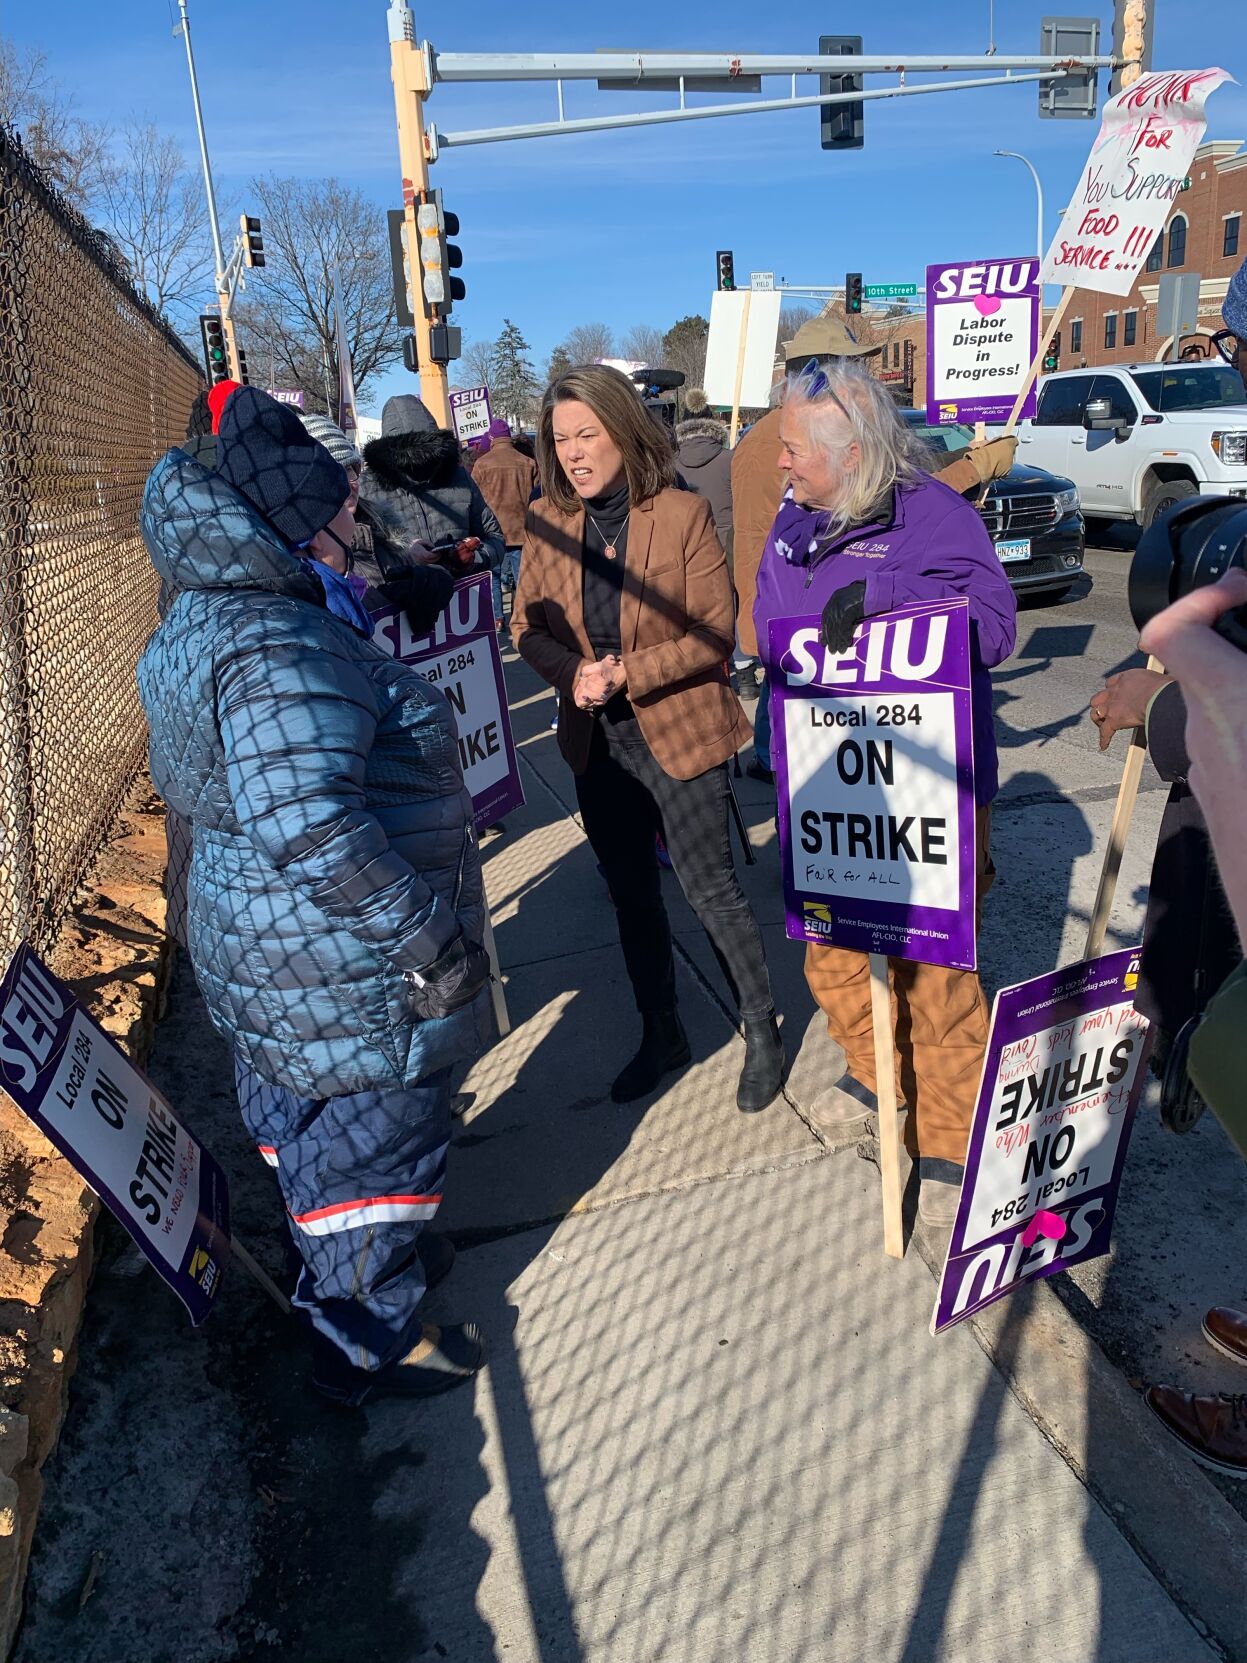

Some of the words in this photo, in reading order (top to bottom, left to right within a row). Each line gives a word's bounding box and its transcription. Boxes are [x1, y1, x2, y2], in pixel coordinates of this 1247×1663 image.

[1131, 114, 1173, 155] FOR
[1077, 208, 1120, 236] FOOD
[868, 287, 886, 296] 10th
[889, 286, 914, 295] Street
[936, 263, 1031, 298] SEIU
[960, 317, 1007, 330] Labor
[953, 332, 1013, 347] Dispute
[976, 350, 990, 361] in
[946, 363, 1020, 381] Progress!
[452, 389, 485, 407] SEIU
[459, 419, 489, 434] STRIKE
[465, 410, 478, 420] ON
[939, 412, 958, 420] SEIU
[869, 544, 890, 552] 284
[787, 615, 949, 687] SEIU
[422, 664, 441, 683] cal
[448, 650, 475, 675] 284
[444, 682, 466, 715] N
[810, 706, 866, 728] Local
[876, 704, 922, 727] 284
[458, 721, 500, 770] IKE
[836, 739, 894, 787] ON
[800, 810, 948, 865] STRIKE
[868, 872, 901, 885] ALL
[804, 919, 832, 934] SEIU
[837, 917, 857, 926] Service
[857, 919, 889, 931] Employees
[890, 924, 929, 938] International
[929, 930, 949, 940] Union
[899, 935, 912, 944] CLC
[1099, 976, 1119, 987] Service
[0, 957, 64, 1093] SEIU
[1017, 1007, 1034, 1018] Union
[56, 1055, 87, 1110] Local
[73, 1029, 94, 1065] 284
[996, 1039, 1134, 1131] STRIKE
[91, 1068, 129, 1131] ON
[129, 1097, 177, 1226] STRIKE
[1021, 1125, 1076, 1185] ON
[1035, 1167, 1090, 1206] Local
[991, 1192, 1030, 1228] 284
[162, 1216, 174, 1235] WE
[951, 1197, 1104, 1316] SEIU
[201, 1257, 217, 1296] SEIU
